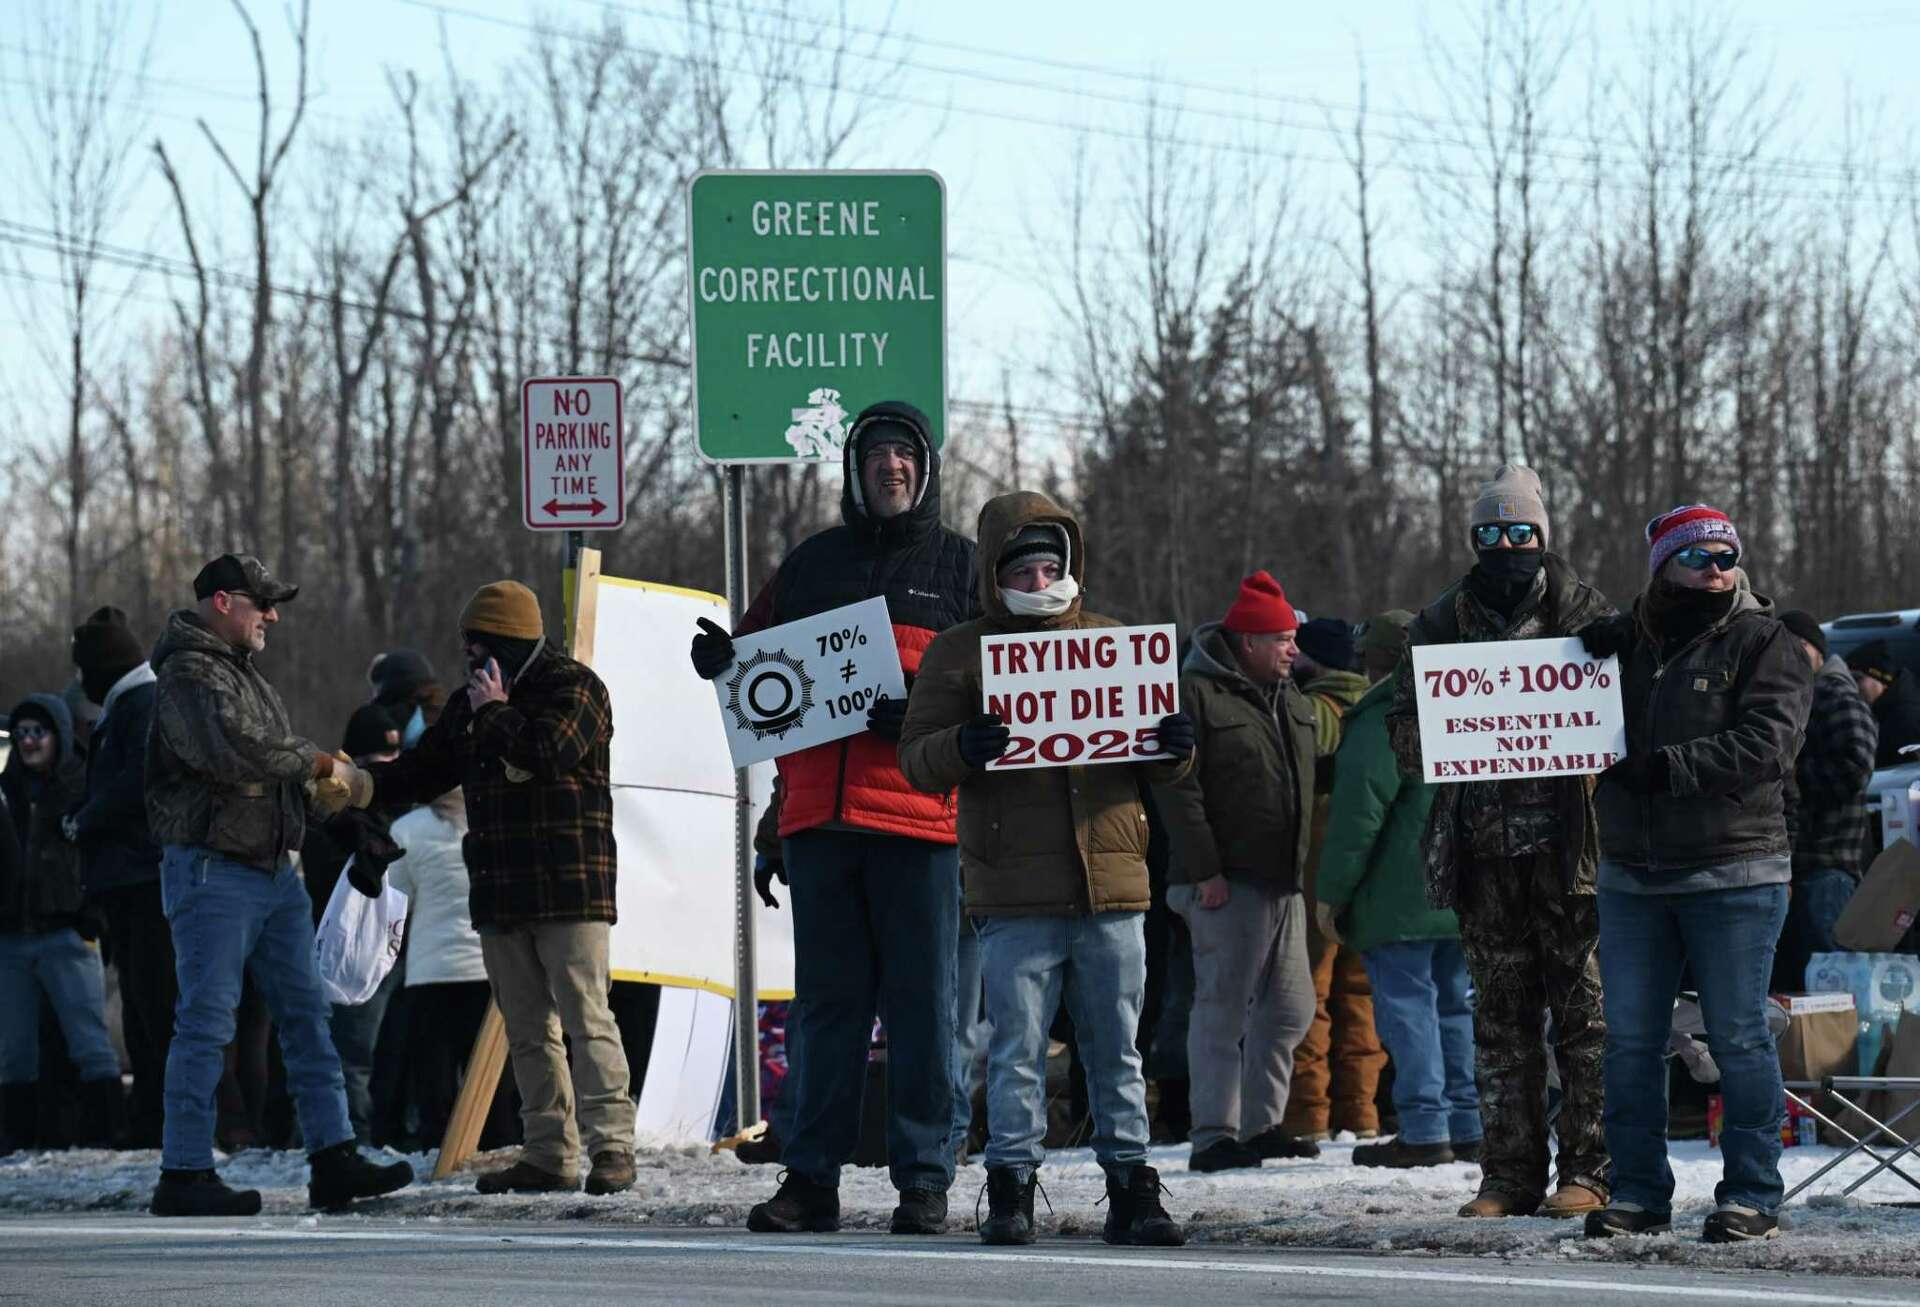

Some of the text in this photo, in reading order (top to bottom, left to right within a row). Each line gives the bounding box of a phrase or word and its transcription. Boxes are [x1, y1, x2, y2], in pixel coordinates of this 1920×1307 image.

[752, 200, 880, 237] GREENE
[700, 265, 935, 303] CORRECTIONAL
[747, 331, 888, 368] FACILITY
[554, 389, 591, 416] NO
[536, 422, 611, 450] PARKING
[555, 454, 592, 473] ANY
[551, 476, 598, 496] TIME
[815, 625, 868, 657] 70%
[987, 632, 1171, 676] TRYING TO
[1424, 668, 1494, 698] 70%
[1517, 661, 1610, 694] 100%
[825, 683, 890, 719] 100%
[988, 682, 1175, 725] NOT DIE IN
[1445, 710, 1600, 734] ESSENTIAL
[994, 729, 1163, 766] 2025
[1496, 735, 1552, 752] NOT
